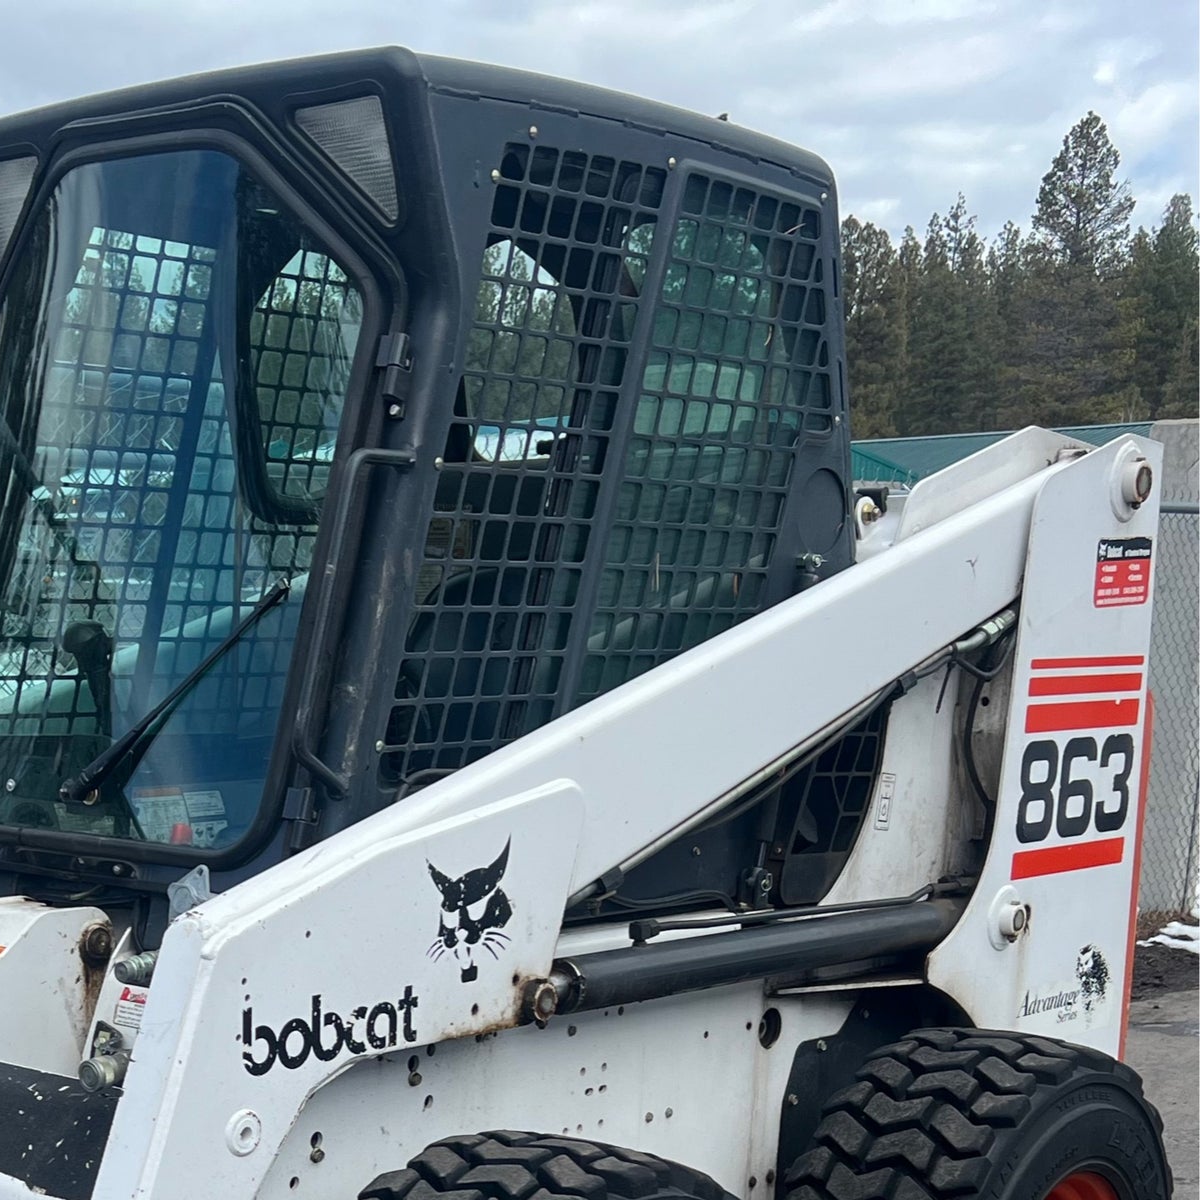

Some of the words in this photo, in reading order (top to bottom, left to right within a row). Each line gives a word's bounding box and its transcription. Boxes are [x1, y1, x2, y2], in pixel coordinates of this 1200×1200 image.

[1015, 733, 1134, 844] 863
[241, 985, 419, 1077] bobcat
[1015, 989, 1080, 1019] Advantage
[1056, 1010, 1078, 1023] Series
